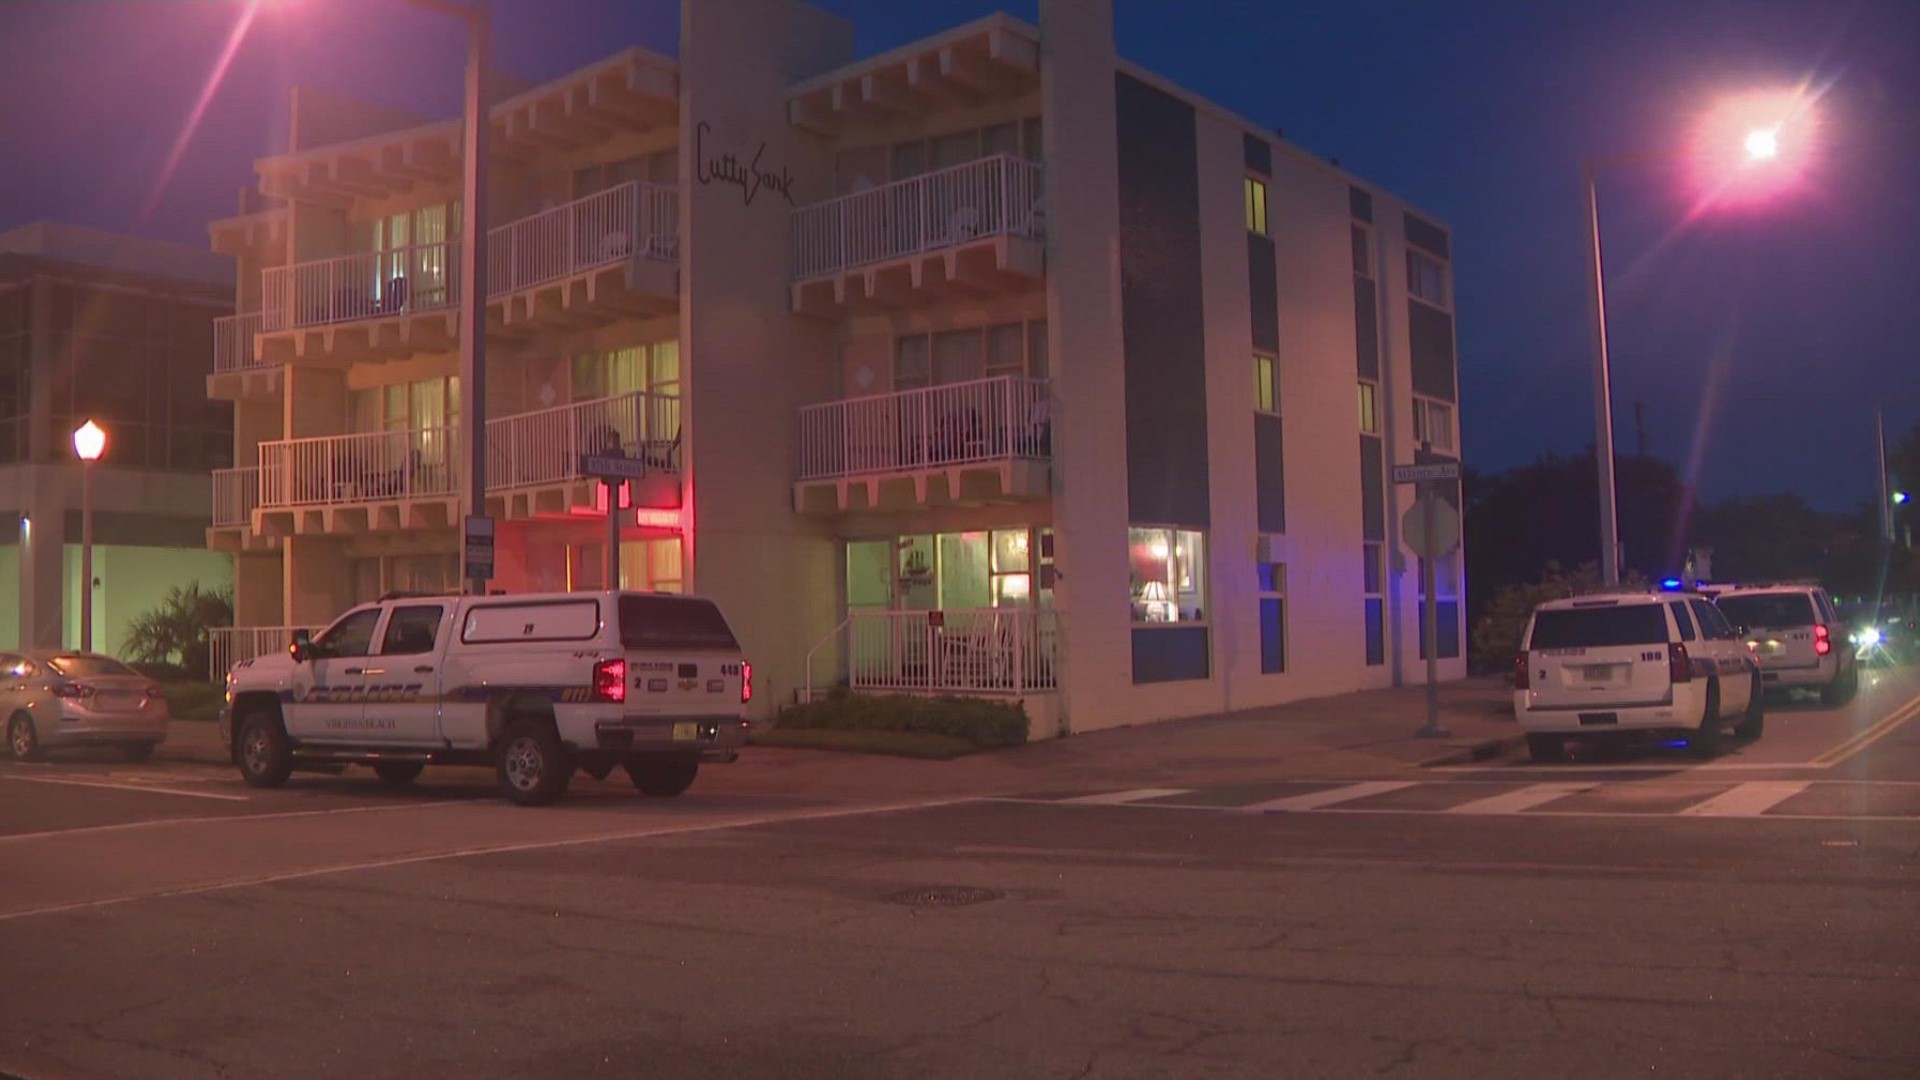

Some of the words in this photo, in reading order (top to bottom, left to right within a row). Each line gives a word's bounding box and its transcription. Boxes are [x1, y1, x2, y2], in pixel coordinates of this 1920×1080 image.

[697, 120, 749, 206] Cutty
[747, 142, 796, 207] Sark
[1397, 467, 1432, 481] Atlantic
[1441, 465, 1456, 478] Ave
[634, 677, 641, 689] 2
